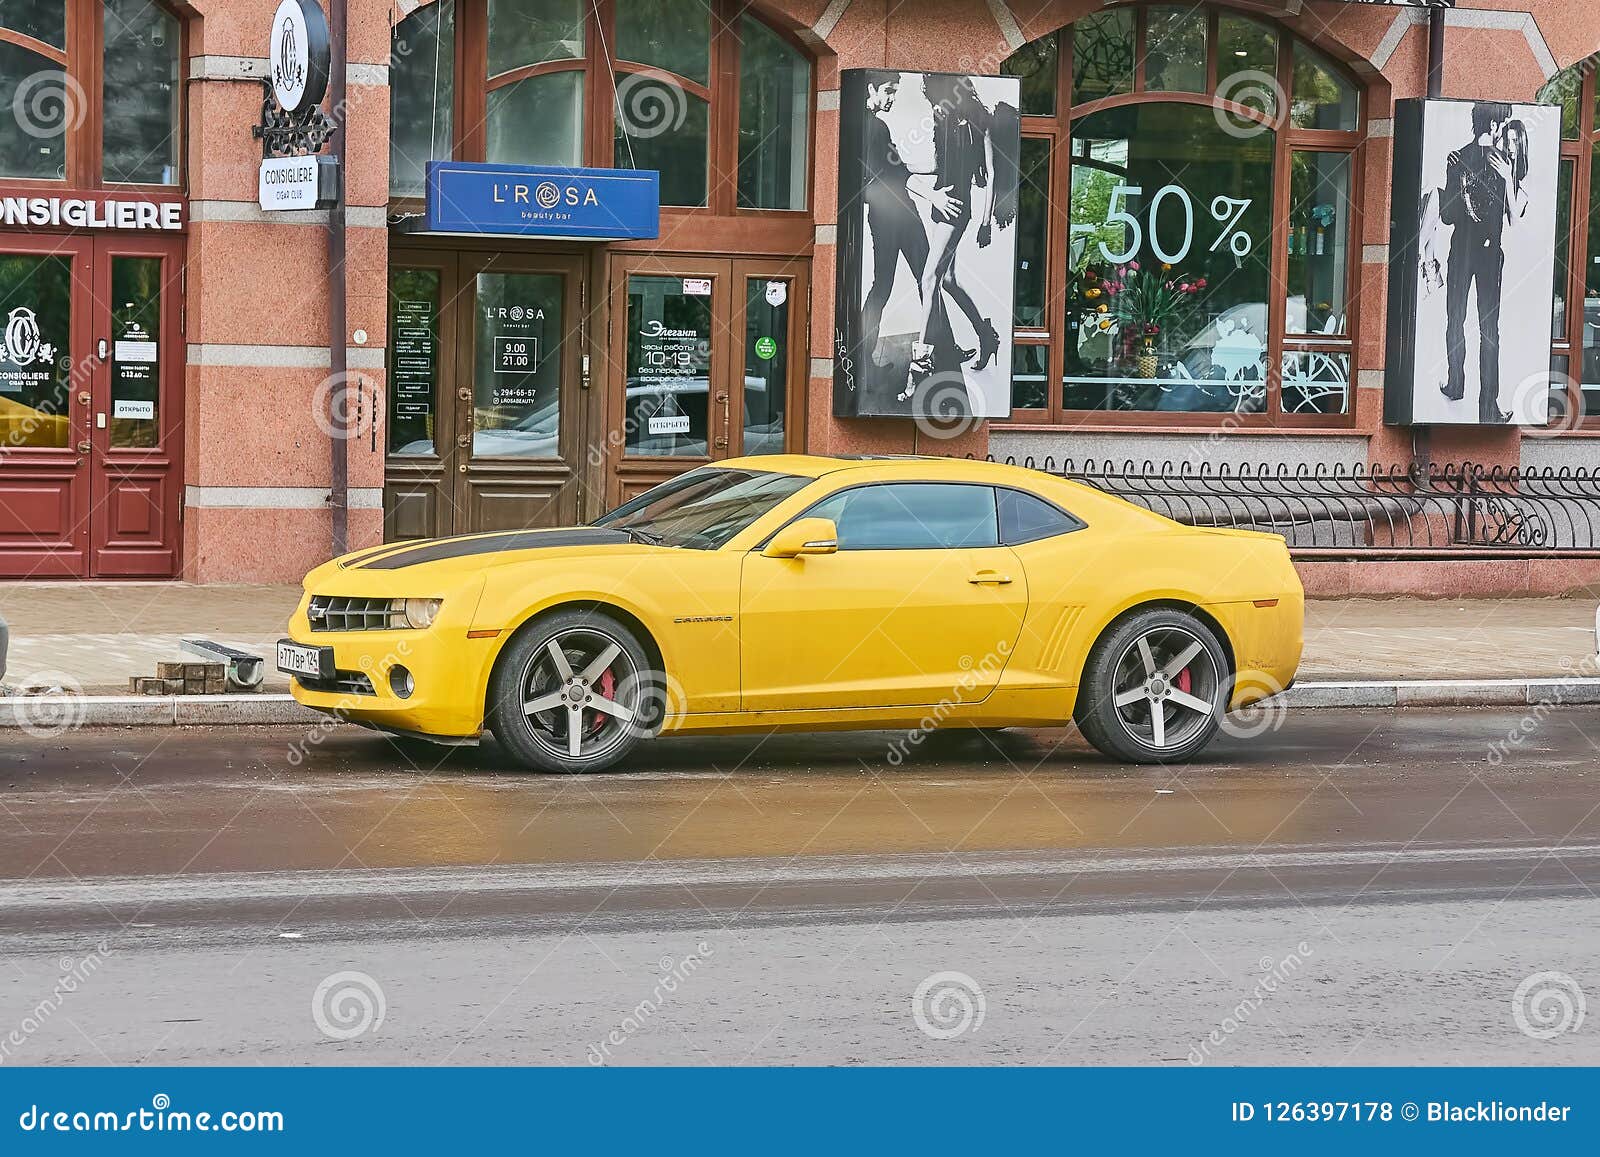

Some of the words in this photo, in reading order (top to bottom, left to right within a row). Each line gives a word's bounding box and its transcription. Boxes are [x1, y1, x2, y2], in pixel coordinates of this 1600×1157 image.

[265, 167, 313, 184] CONSIGLIERE
[276, 190, 289, 200] CIGAR
[291, 190, 302, 199] CLUB
[0, 197, 182, 230] NSIGLIERE
[521, 211, 554, 220] beauty
[640, 320, 697, 337] Элегант
[505, 343, 526, 353] 9.00
[663, 343, 695, 352] работы
[502, 355, 529, 366] 21.00
[645, 351, 691, 366] 10-19
[638, 366, 655, 374] без
[500, 388, 537, 397] 294-65-57
[305, 651, 318, 669] 124
